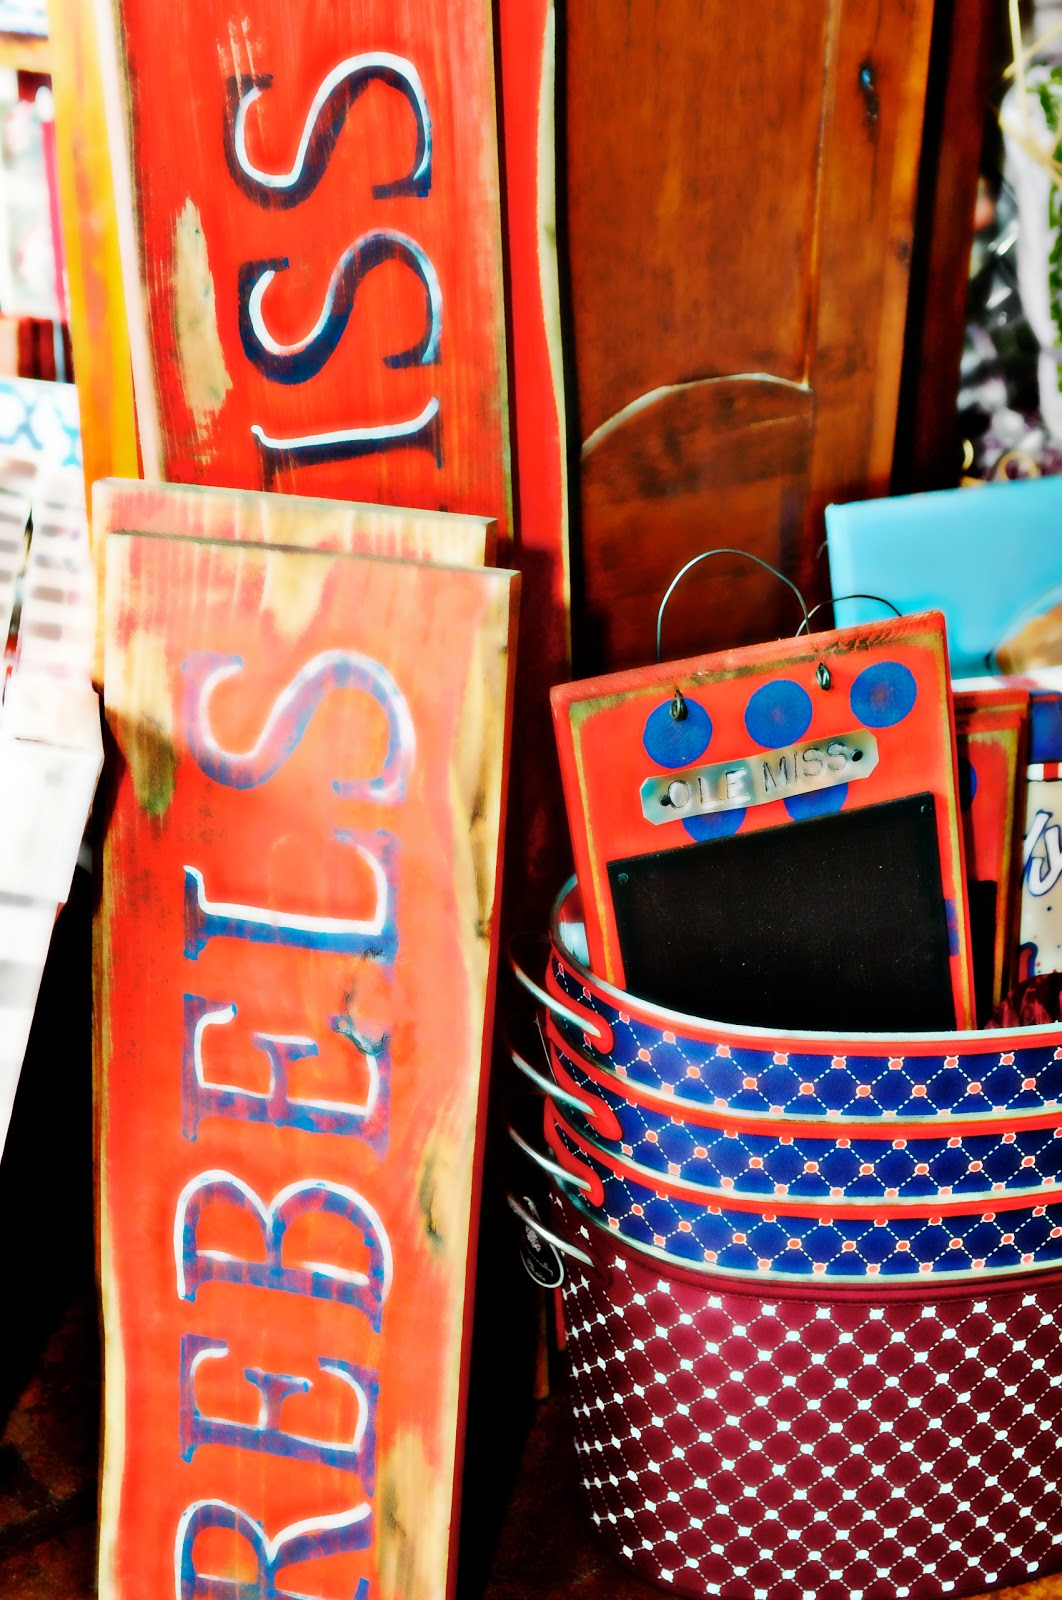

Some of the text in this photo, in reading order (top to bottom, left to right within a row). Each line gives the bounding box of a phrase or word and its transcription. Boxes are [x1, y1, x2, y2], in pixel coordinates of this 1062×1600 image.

[223, 51, 448, 500] ISS
[667, 741, 848, 809] OLE MISS
[173, 649, 416, 1600] REBELS
